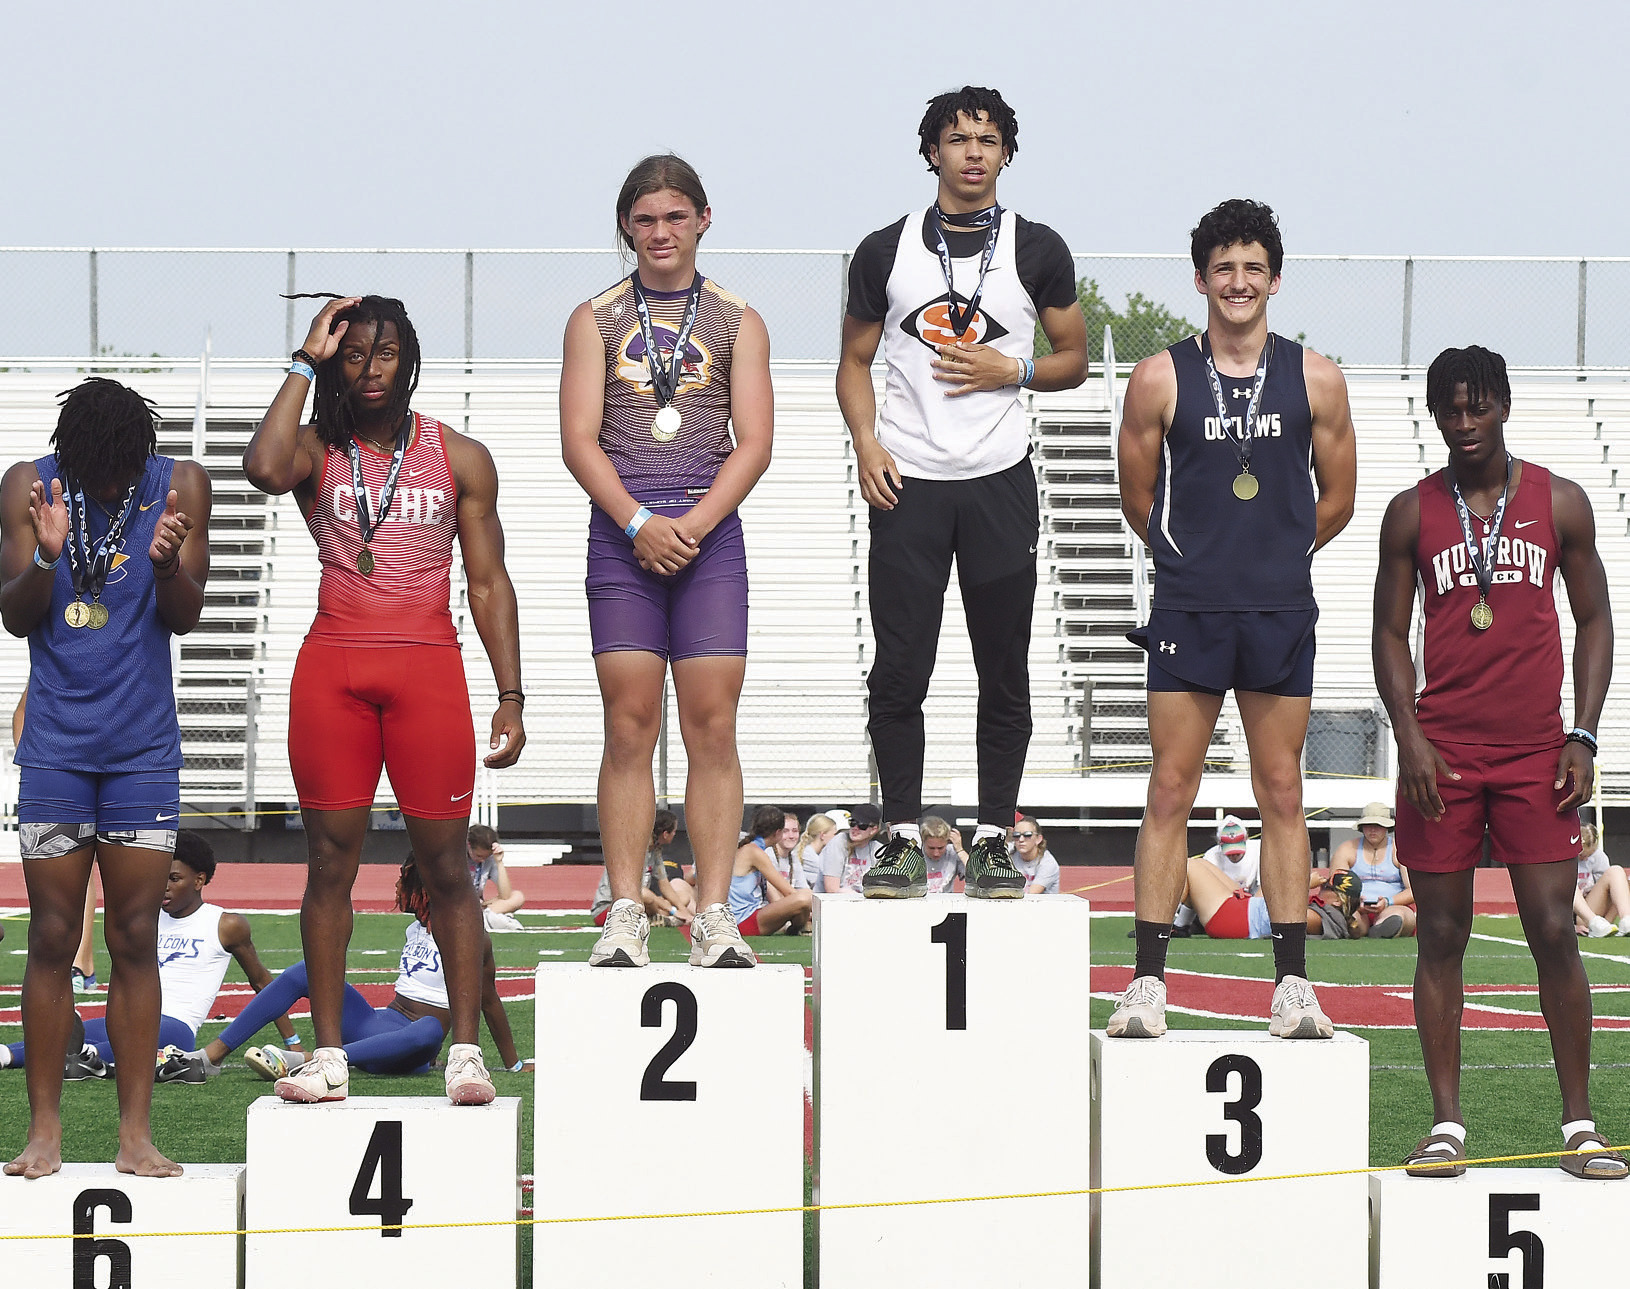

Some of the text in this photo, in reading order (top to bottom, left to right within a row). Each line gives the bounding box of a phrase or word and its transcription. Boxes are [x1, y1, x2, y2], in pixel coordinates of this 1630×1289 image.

[350, 439, 361, 482] OSSA
[1204, 414, 1281, 441] OULWS
[1432, 535, 1548, 596] MUROW
[1467, 572, 1515, 584] TCK
[158, 937, 205, 958] LCONS
[931, 913, 967, 1030] 1
[640, 982, 697, 1101] 2
[1206, 1054, 1262, 1174] 3
[349, 1121, 413, 1237] 4
[73, 1189, 132, 1289] 6
[1488, 1194, 1544, 1289] 5
